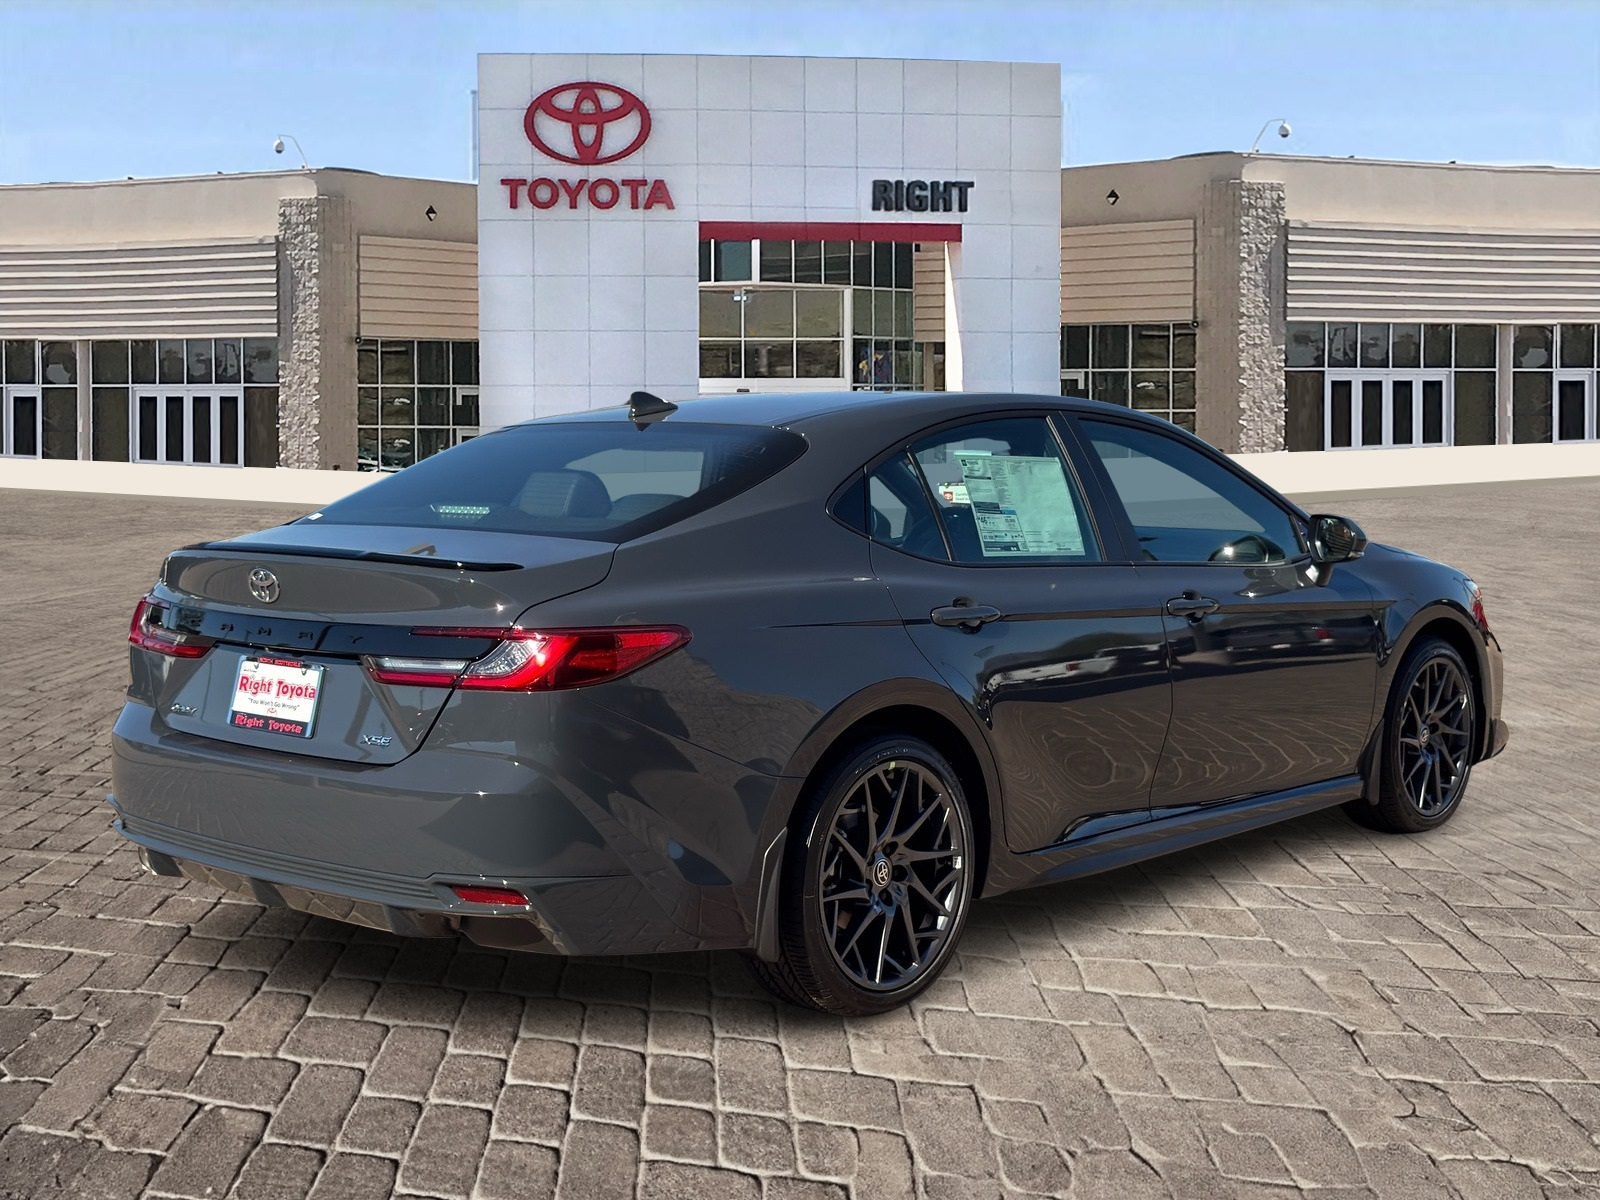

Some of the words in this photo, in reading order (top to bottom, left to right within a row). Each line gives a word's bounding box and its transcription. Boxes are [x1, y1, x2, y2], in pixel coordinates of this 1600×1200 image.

[500, 177, 675, 210] TOYOTA
[872, 179, 974, 212] RIGHT
[239, 674, 273, 696] Right
[276, 680, 317, 700] Toyota
[235, 713, 264, 728] Right
[268, 719, 303, 734] Toyota
[360, 734, 392, 747] XSE
